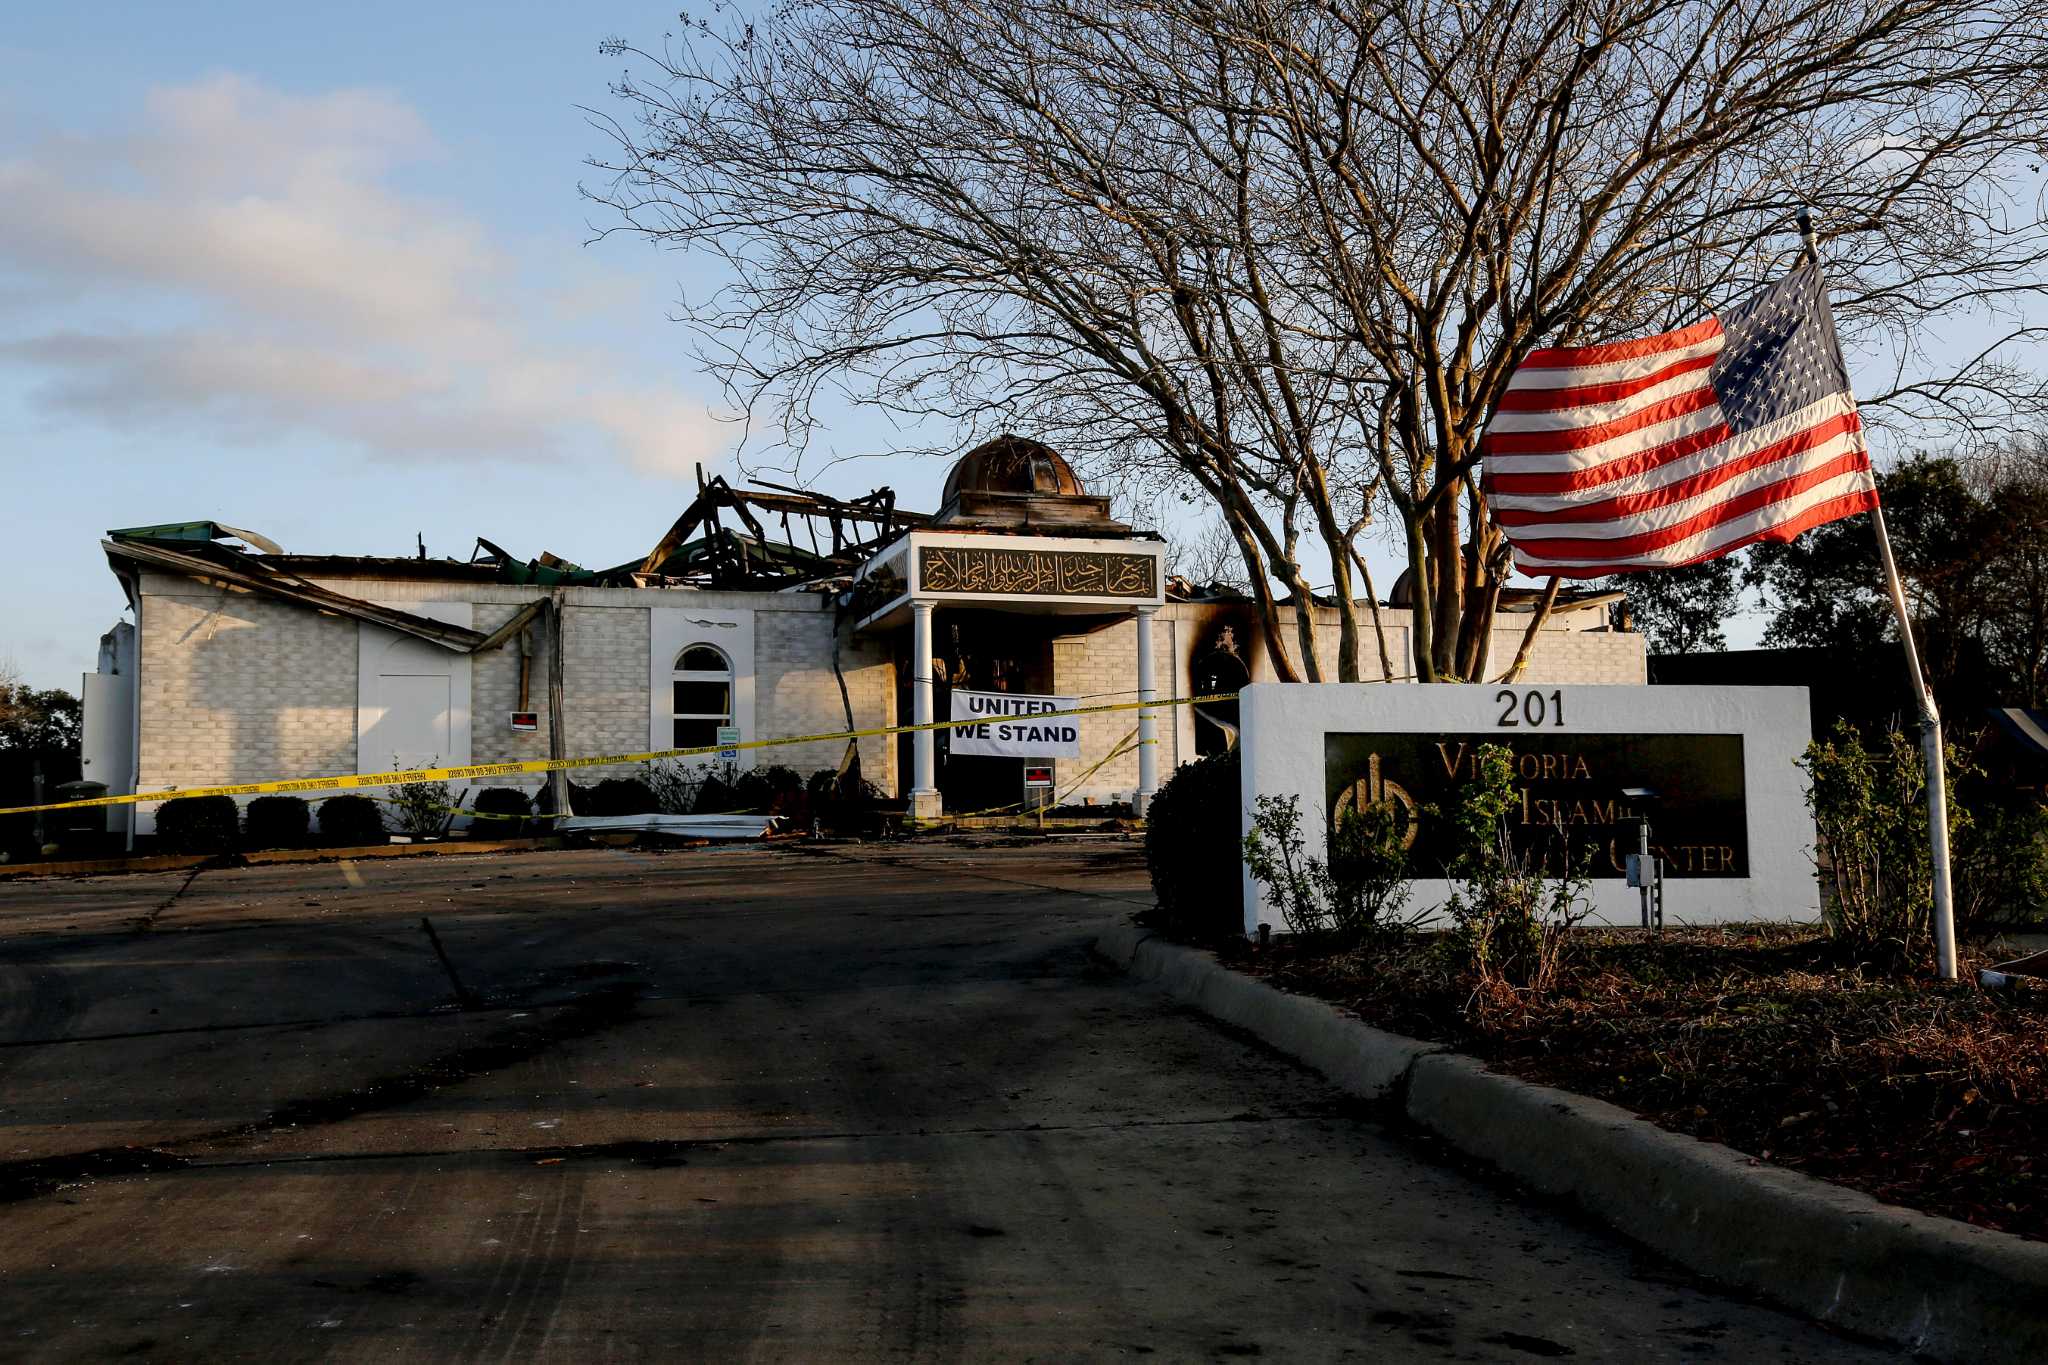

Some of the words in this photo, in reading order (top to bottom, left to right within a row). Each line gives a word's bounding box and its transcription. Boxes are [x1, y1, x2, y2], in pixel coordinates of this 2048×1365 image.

[969, 697, 1056, 717] UNITED
[1496, 689, 1565, 727] 201
[955, 723, 990, 739] WE
[998, 725, 1077, 742] STAND
[1435, 742, 1592, 780] VIORIA
[1520, 787, 1638, 825] ISLAM
[1609, 836, 1736, 872] CNTER
